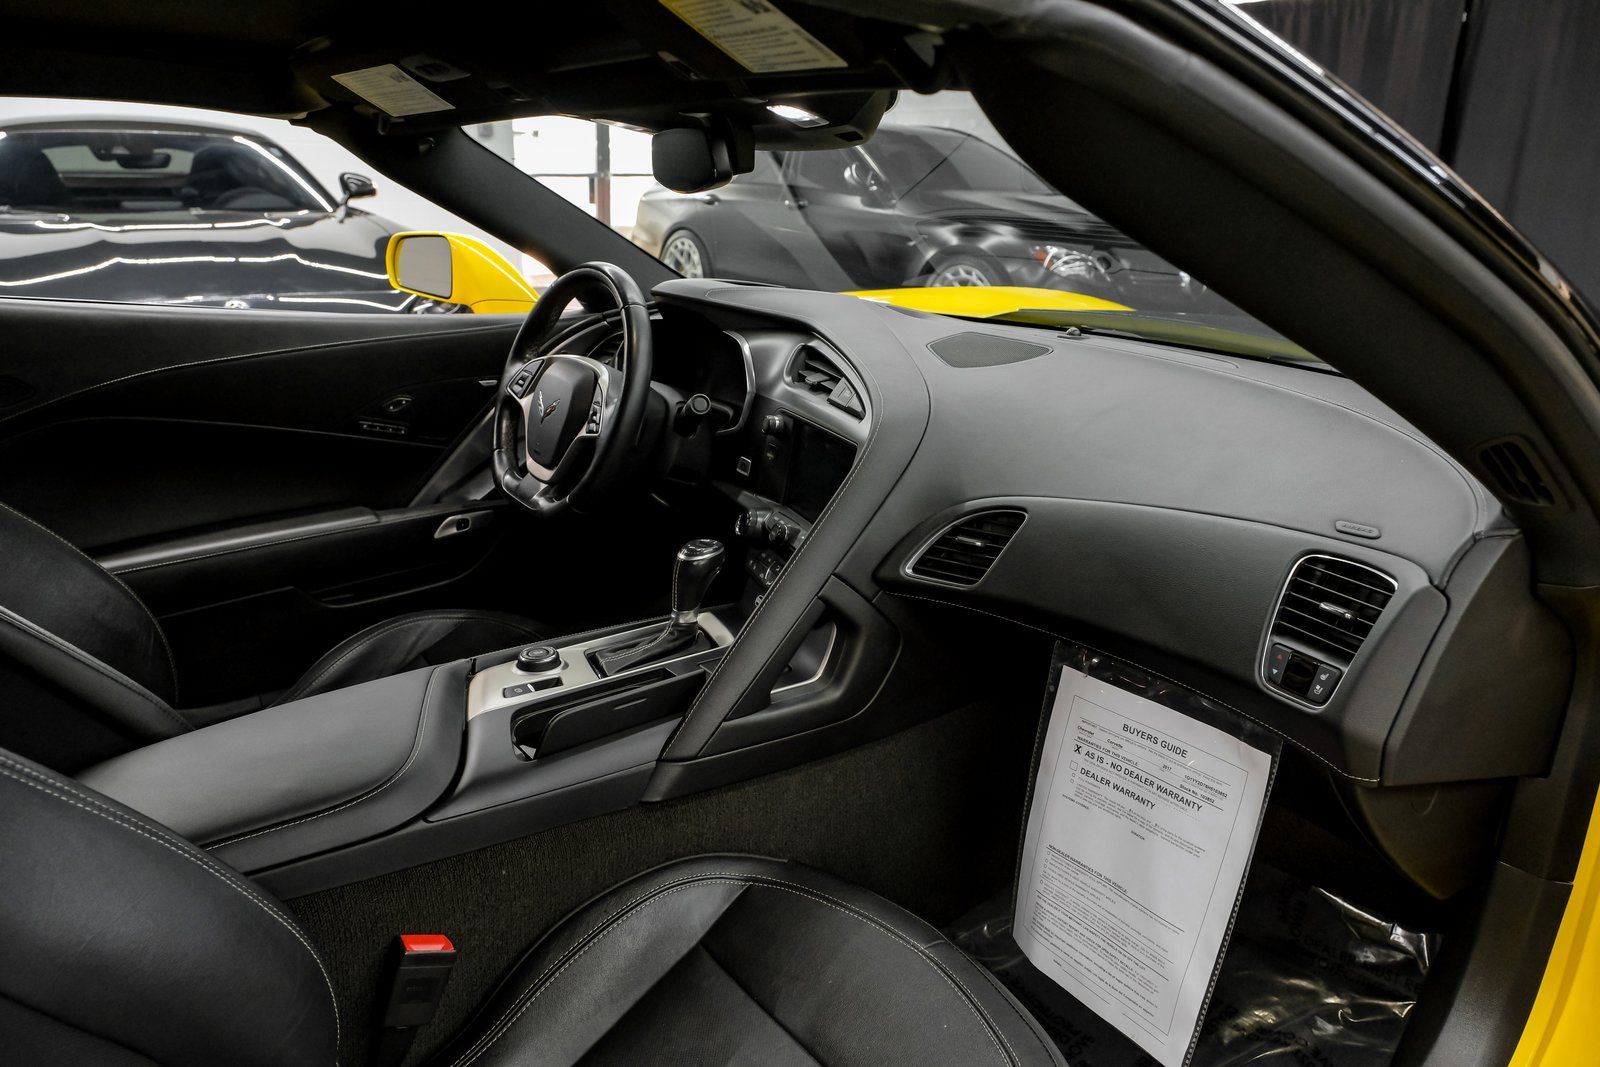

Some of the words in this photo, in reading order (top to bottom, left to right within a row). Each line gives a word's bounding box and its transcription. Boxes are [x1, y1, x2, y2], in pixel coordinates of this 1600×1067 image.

[1077, 725, 1095, 736] Chevrolet
[1106, 738, 1123, 749] Corvette
[1077, 736, 1101, 750] WARRANTIES
[1111, 751, 1120, 759] THIS
[1122, 723, 1159, 745] BUYERS
[1160, 740, 1188, 759] GUIDE
[1074, 743, 1082, 755] X
[1084, 750, 1095, 760] AS
[1096, 755, 1105, 764] IS
[1110, 761, 1122, 772] NO
[1123, 768, 1155, 788] DEALER
[1156, 783, 1202, 812] WARRANTY
[1080, 767, 1111, 787] DEALER
[1112, 782, 1156, 810] WARRANTY
[1179, 784, 1191, 792] Stock
[1070, 856, 1094, 873] WARRANTIES
